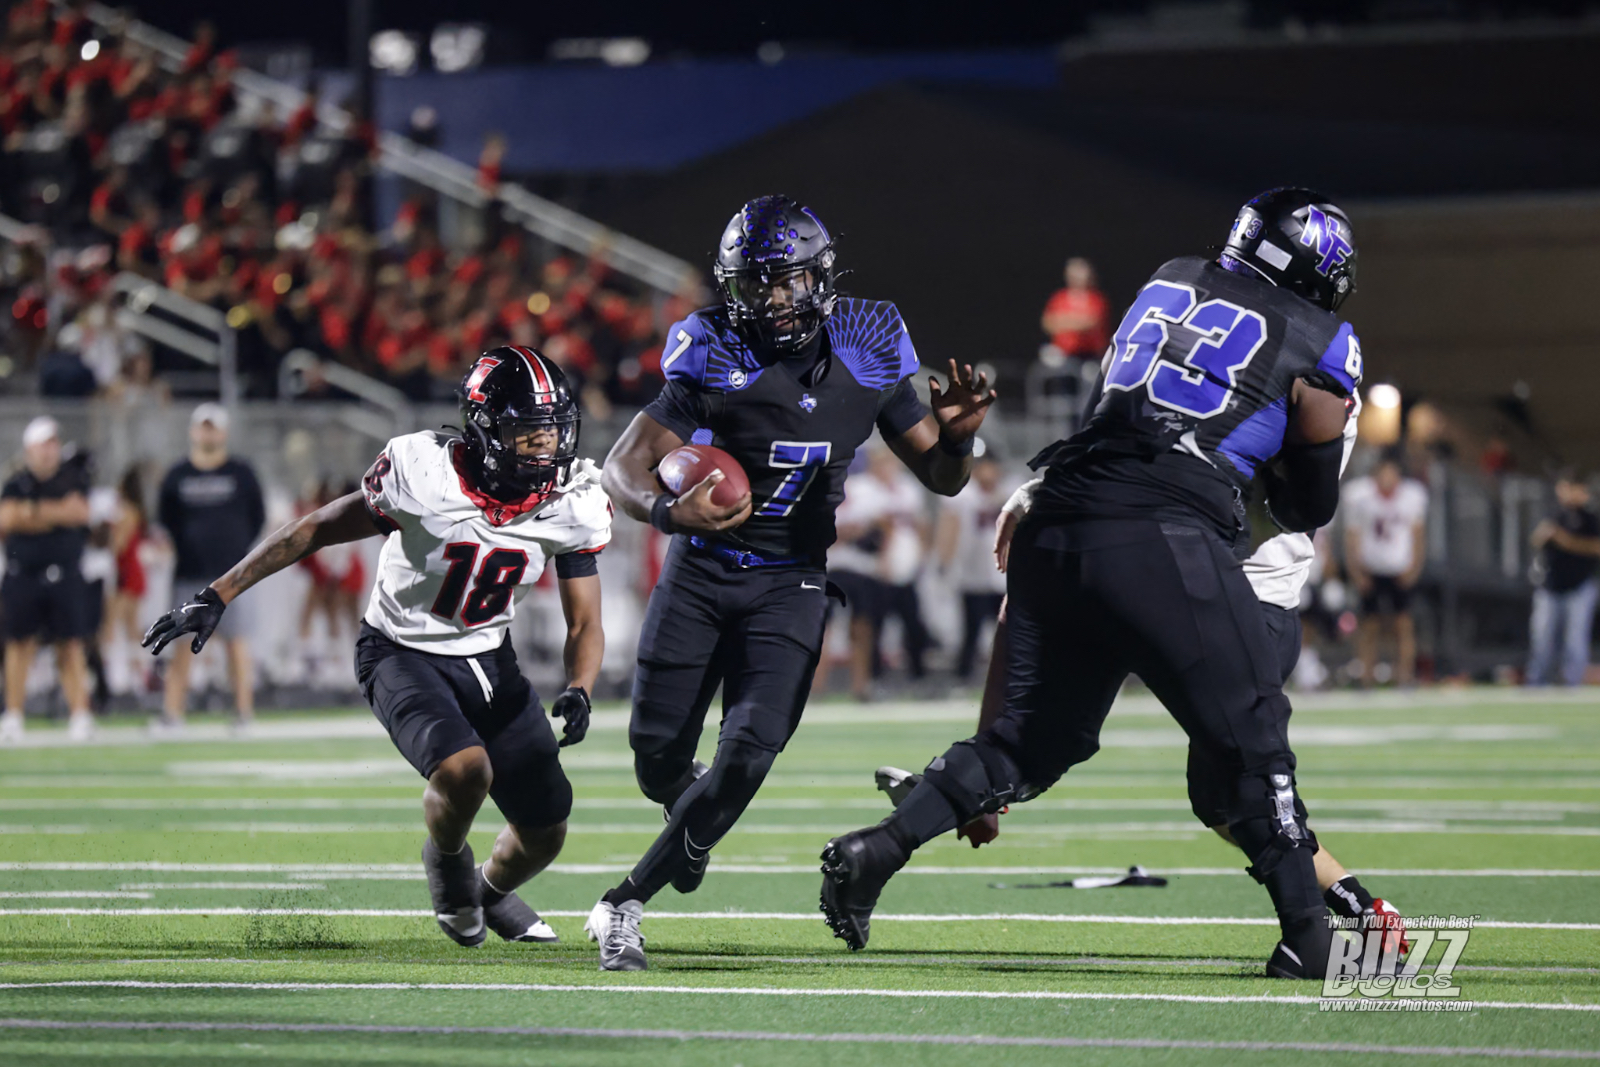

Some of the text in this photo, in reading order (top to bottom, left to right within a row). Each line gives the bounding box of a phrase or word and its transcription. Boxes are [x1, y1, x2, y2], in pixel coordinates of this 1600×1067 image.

[1300, 204, 1353, 276] NF
[663, 329, 693, 369] 7
[1103, 279, 1267, 419] 63
[754, 440, 832, 516] 7
[431, 541, 530, 627] 18
